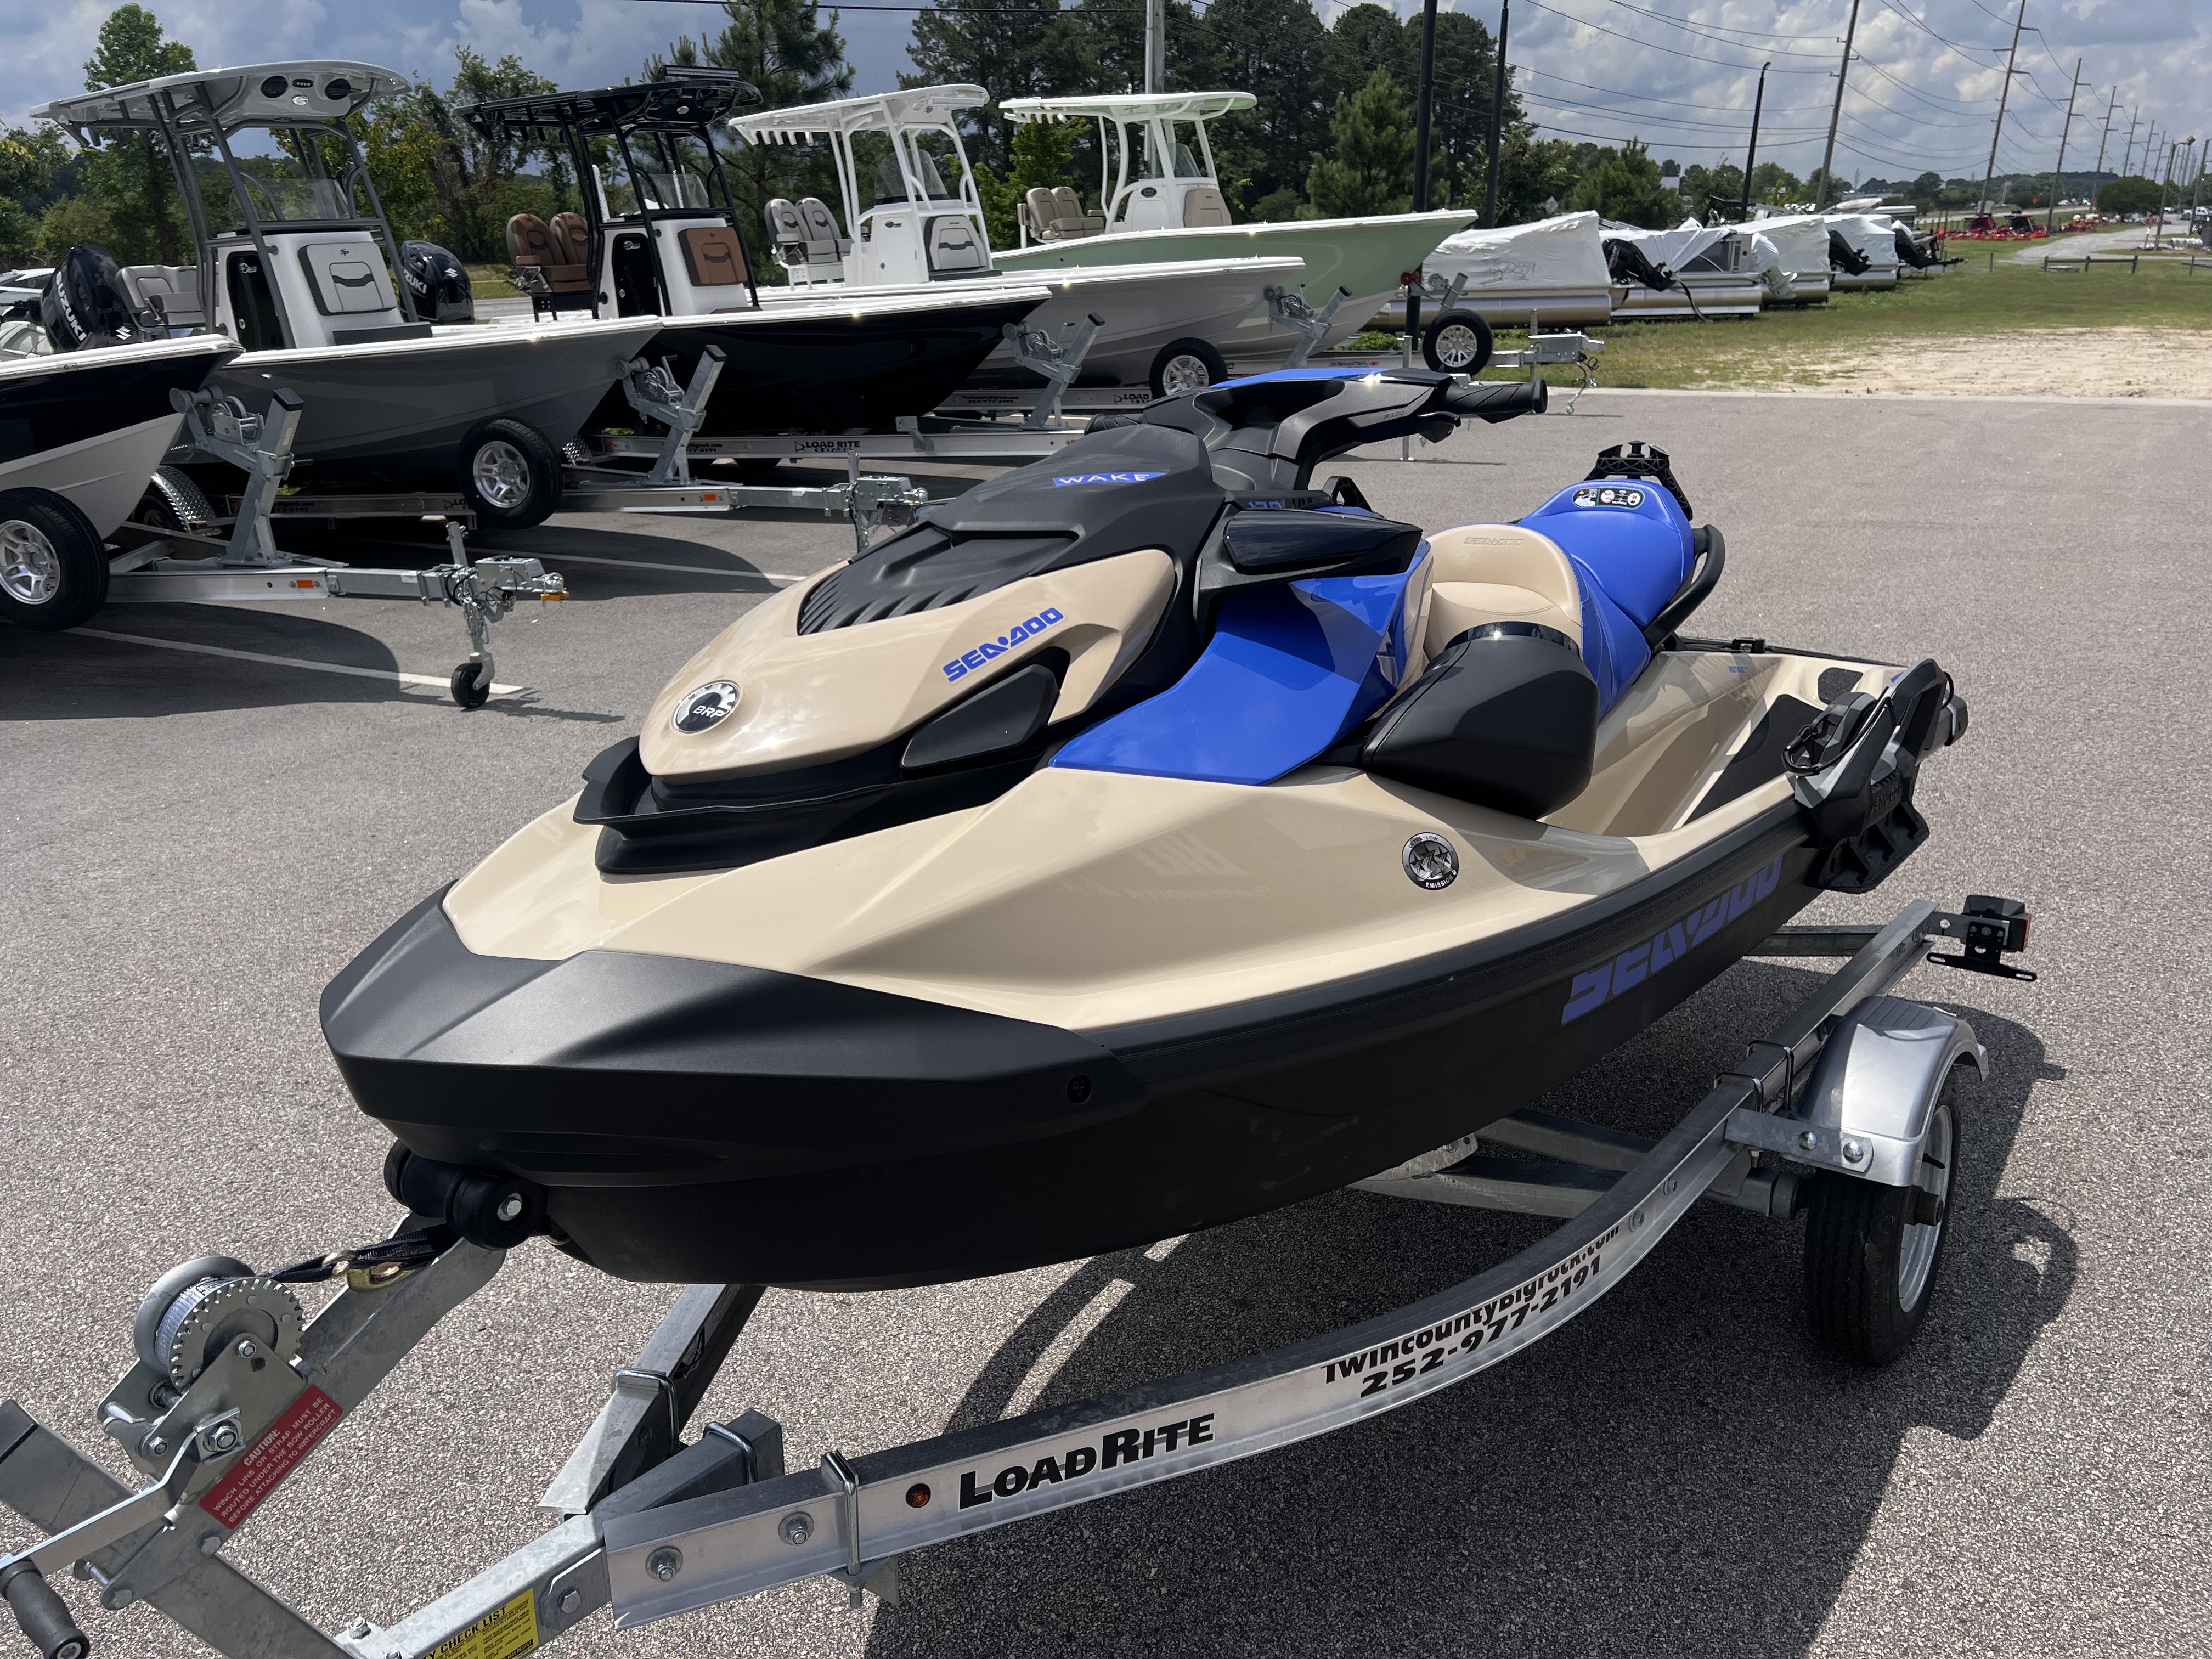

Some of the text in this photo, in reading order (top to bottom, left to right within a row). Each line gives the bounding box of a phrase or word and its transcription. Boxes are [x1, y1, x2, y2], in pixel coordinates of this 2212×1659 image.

[403, 268, 428, 294] ZUKI
[55, 271, 87, 341] SUZUKI
[1059, 473, 1150, 484] WAKE
[692, 705, 725, 718] BRP
[1408, 836, 1423, 849] ULTRA
[1425, 874, 1454, 889] EMISSION
[1360, 1255, 1601, 1398] 252-977-2191
[213, 1397, 323, 1511] WINCH LINE OR STRAP MUST BE
[221, 1489, 249, 1517] ROUTED
[249, 1463, 274, 1488] UNDER
[272, 1448, 287, 1464] THE
[286, 1431, 304, 1448] BOW
[303, 1403, 330, 1431] ROLLER
[228, 1496, 256, 1523] BEFORE
[255, 1460, 290, 1496] ATTACHING
[289, 1450, 298, 1459] TO
[296, 1409, 336, 1451] WATERCRAFT
[243, 1429, 281, 1466] CAUTION:
[441, 1624, 480, 1654] CHECK
[483, 1605, 507, 1627] LIST
